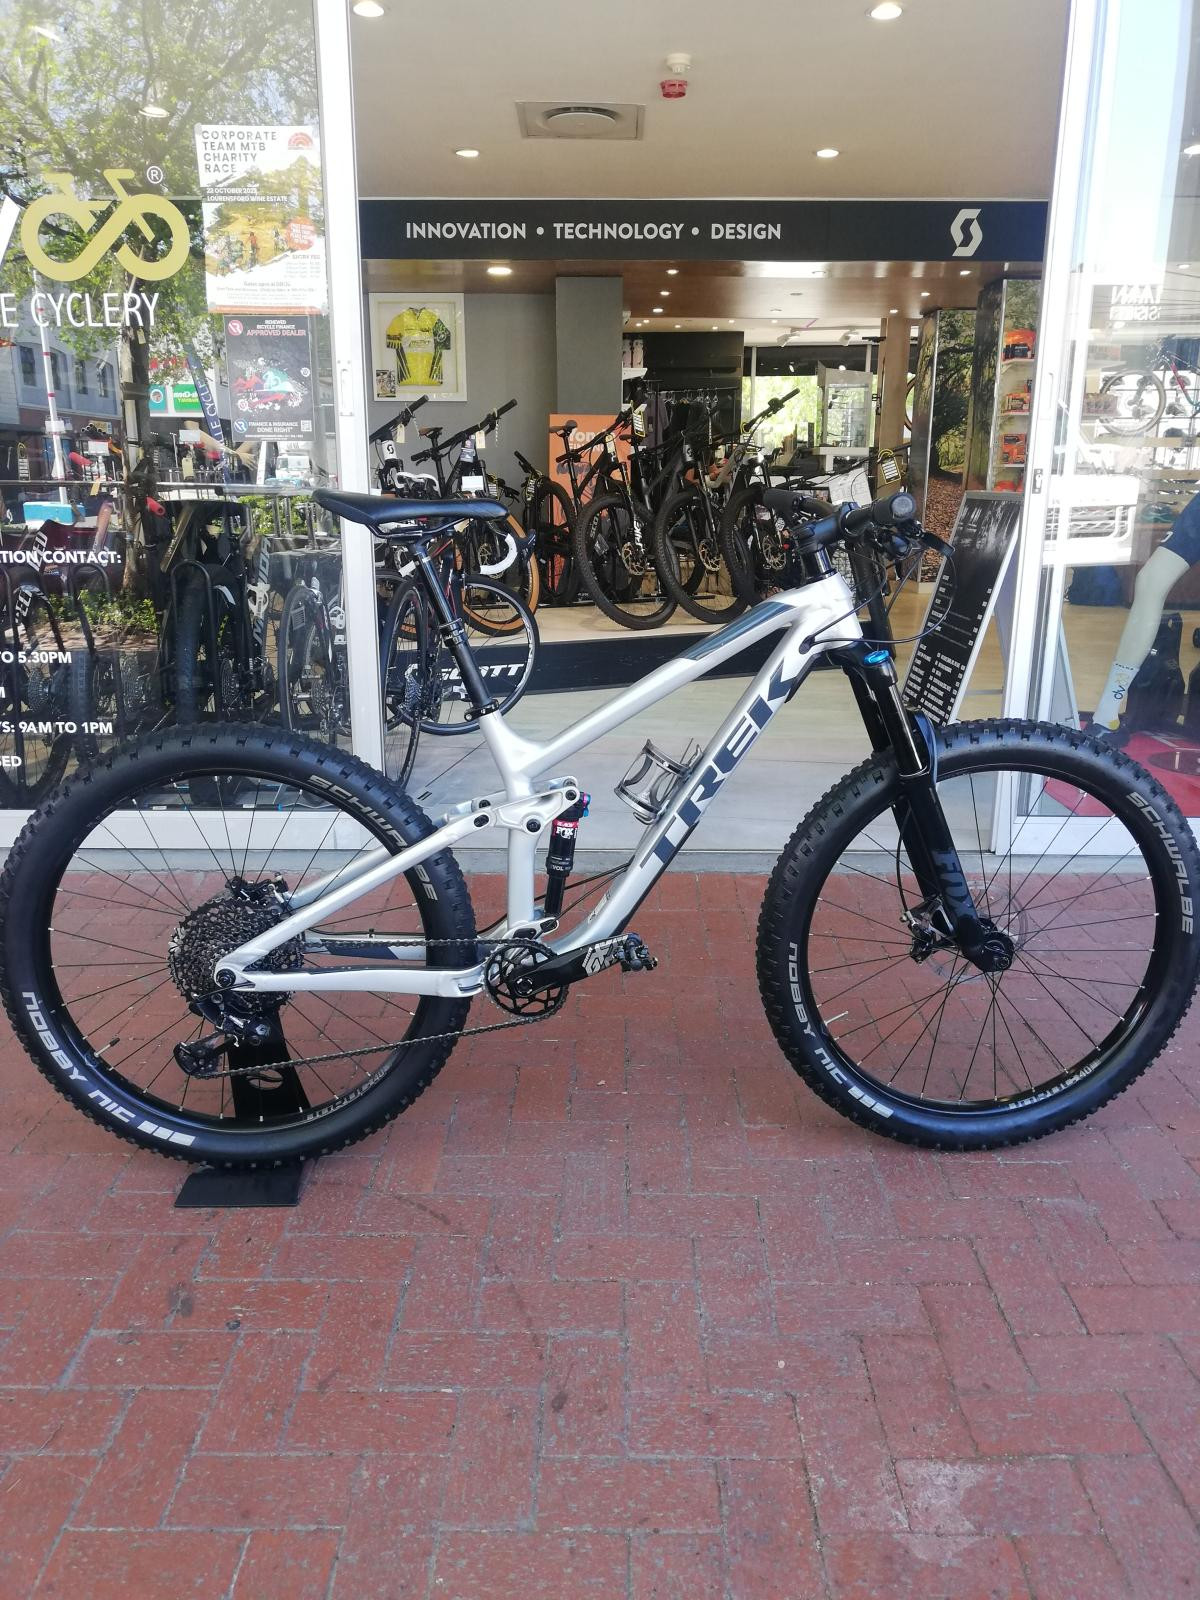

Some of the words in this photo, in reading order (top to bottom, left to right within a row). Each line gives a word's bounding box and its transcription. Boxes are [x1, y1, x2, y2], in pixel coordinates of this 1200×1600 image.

[201, 130, 278, 141] CORPORATE
[203, 141, 236, 151] TEAM
[240, 142, 267, 152] MTB
[203, 152, 258, 162] CHARITY
[204, 163, 238, 173] RACE
[405, 222, 527, 240] INNOVATION
[553, 222, 684, 241] TECHNOLOGY
[711, 223, 782, 241] DESIGN
[30, 292, 160, 328] CYCLERY
[246, 329, 281, 337] APPROVED
[282, 329, 307, 337] DEALER
[42, 550, 122, 564] CONTACT:
[17, 651, 73, 664] 5.30PM
[18, 721, 53, 734] 9AM
[55, 721, 78, 734] TO
[81, 721, 114, 734] 1PM
[638, 657, 798, 870] TREK
[1126, 791, 1194, 936] SCHWALBE
[788, 941, 817, 1038] NOBBY
[814, 1046, 849, 1086] NIC
[21, 991, 89, 1083] NOBBY
[87, 1089, 137, 1124] NIC
